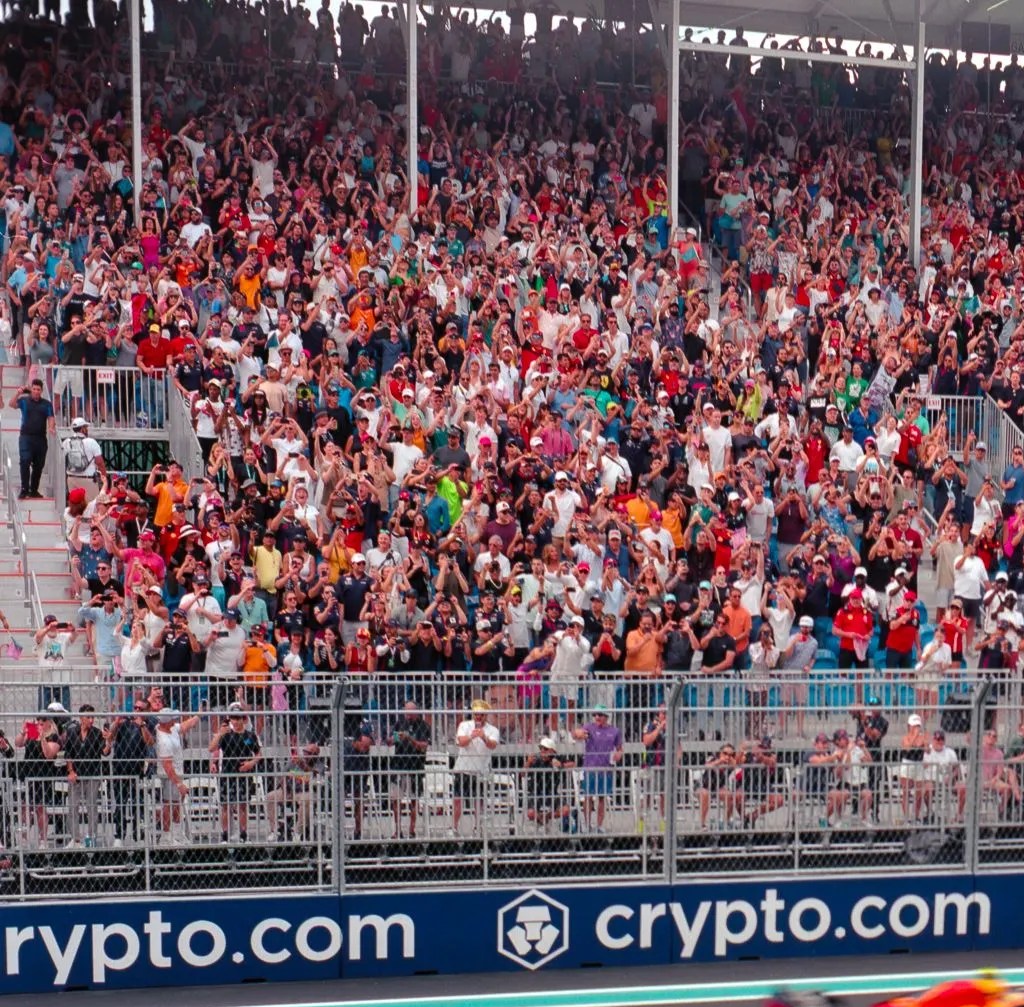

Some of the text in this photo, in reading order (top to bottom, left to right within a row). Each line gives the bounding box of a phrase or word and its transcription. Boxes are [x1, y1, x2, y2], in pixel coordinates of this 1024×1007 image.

[98, 371, 113, 379] EXIT
[928, 399, 941, 407] EXIT
[595, 889, 991, 958] crypto.com
